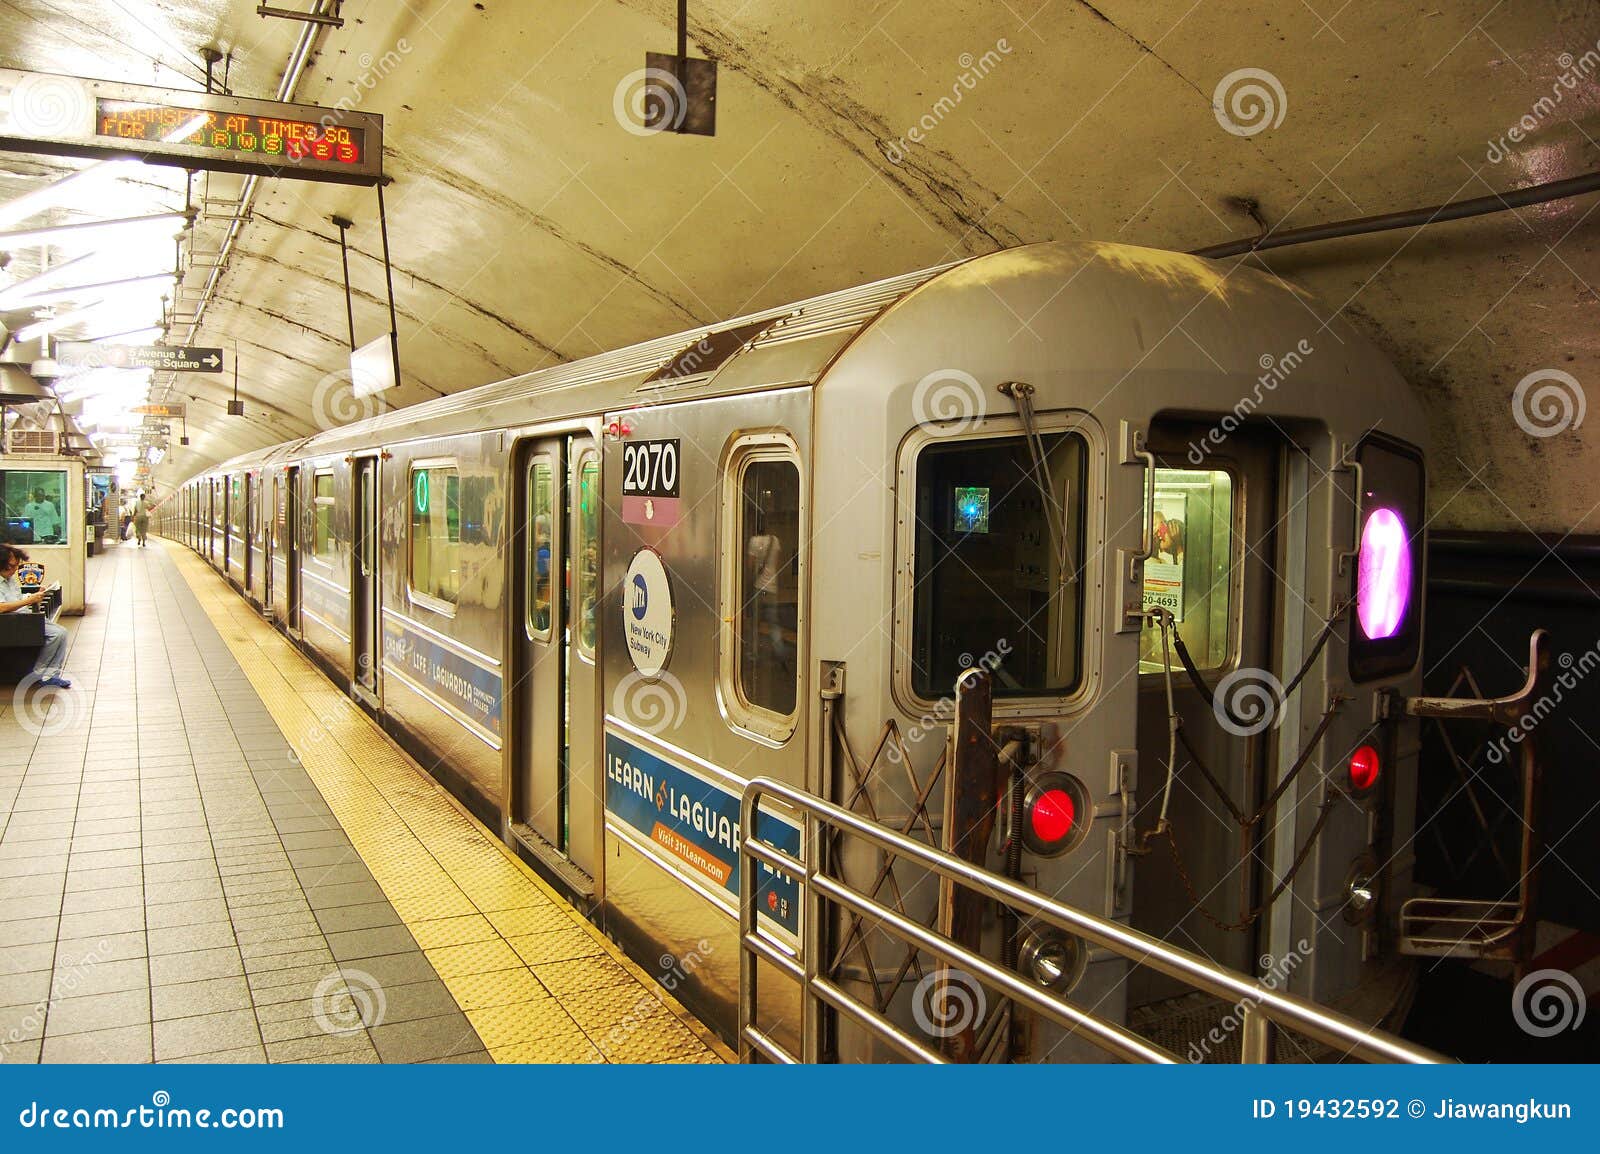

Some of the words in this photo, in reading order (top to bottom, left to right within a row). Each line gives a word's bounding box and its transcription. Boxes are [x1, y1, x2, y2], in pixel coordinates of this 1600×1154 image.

[225, 116, 249, 134] AT
[258, 119, 317, 141] TIMES
[325, 127, 351, 145] SQ
[129, 357, 160, 367] Times
[163, 358, 199, 369] Square
[139, 348, 175, 358] Avenue
[177, 350, 186, 359] &
[624, 442, 676, 491] 2070
[630, 622, 642, 636] New
[642, 627, 655, 642] York
[655, 633, 667, 649] City
[630, 638, 651, 659] Subway
[413, 648, 427, 674] LIFE
[432, 663, 473, 703] LAGUARDIA
[608, 753, 654, 802] LEARN
[657, 827, 674, 848] Visit
[675, 837, 723, 880] 311Learn.com
